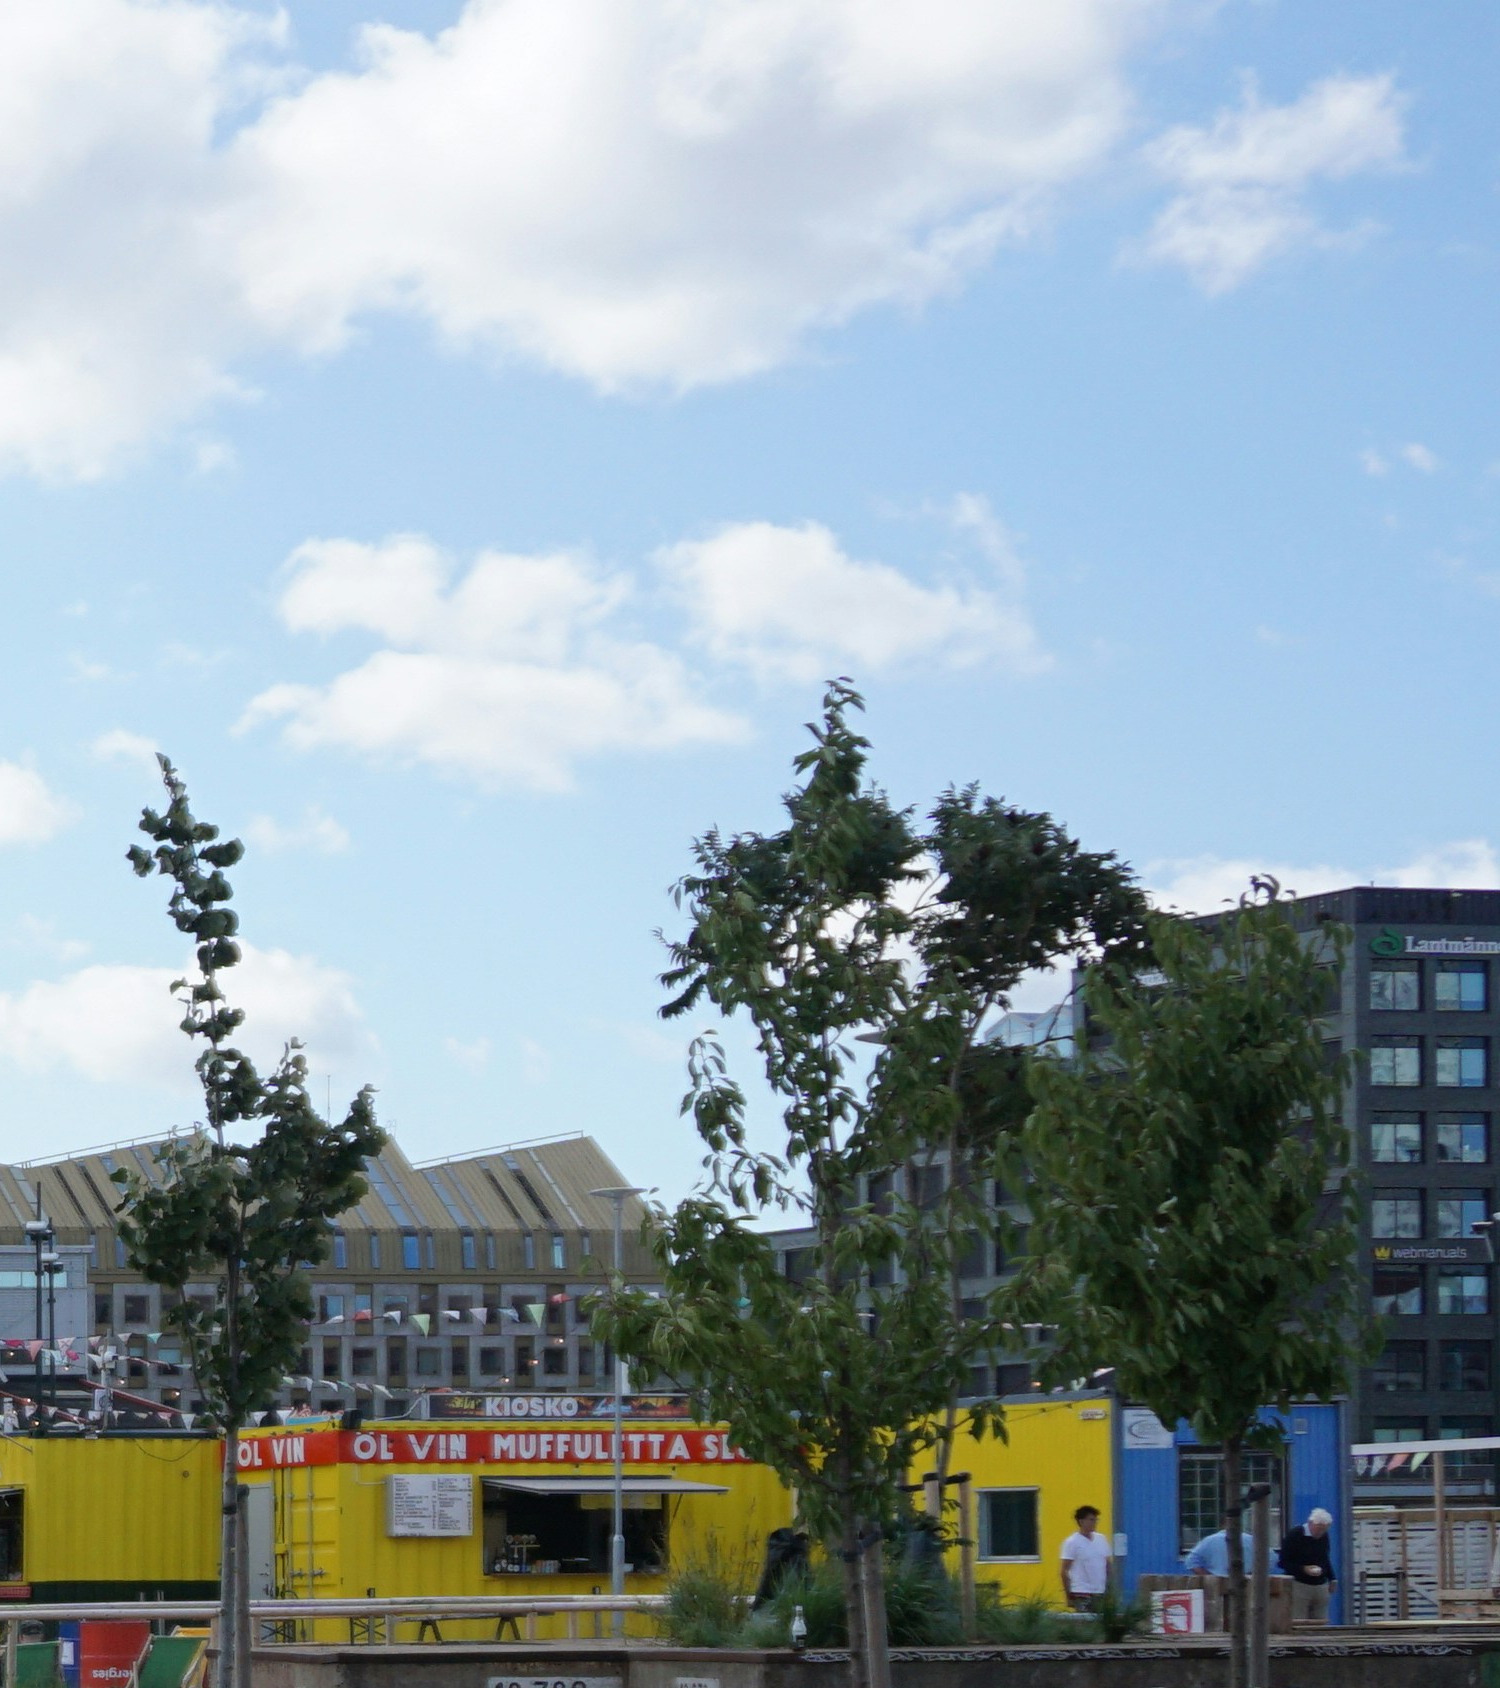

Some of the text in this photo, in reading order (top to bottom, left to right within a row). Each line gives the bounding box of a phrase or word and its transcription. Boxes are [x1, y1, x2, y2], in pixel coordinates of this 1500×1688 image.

[1393, 1246, 1467, 1259] webmanuals
[486, 1398, 579, 1418] KIOSKO
[237, 1436, 305, 1467] ÖL VIN
[353, 1432, 394, 1460] ÖL
[408, 1434, 467, 1460] VIN
[493, 1433, 691, 1460] MUFFULETTA
